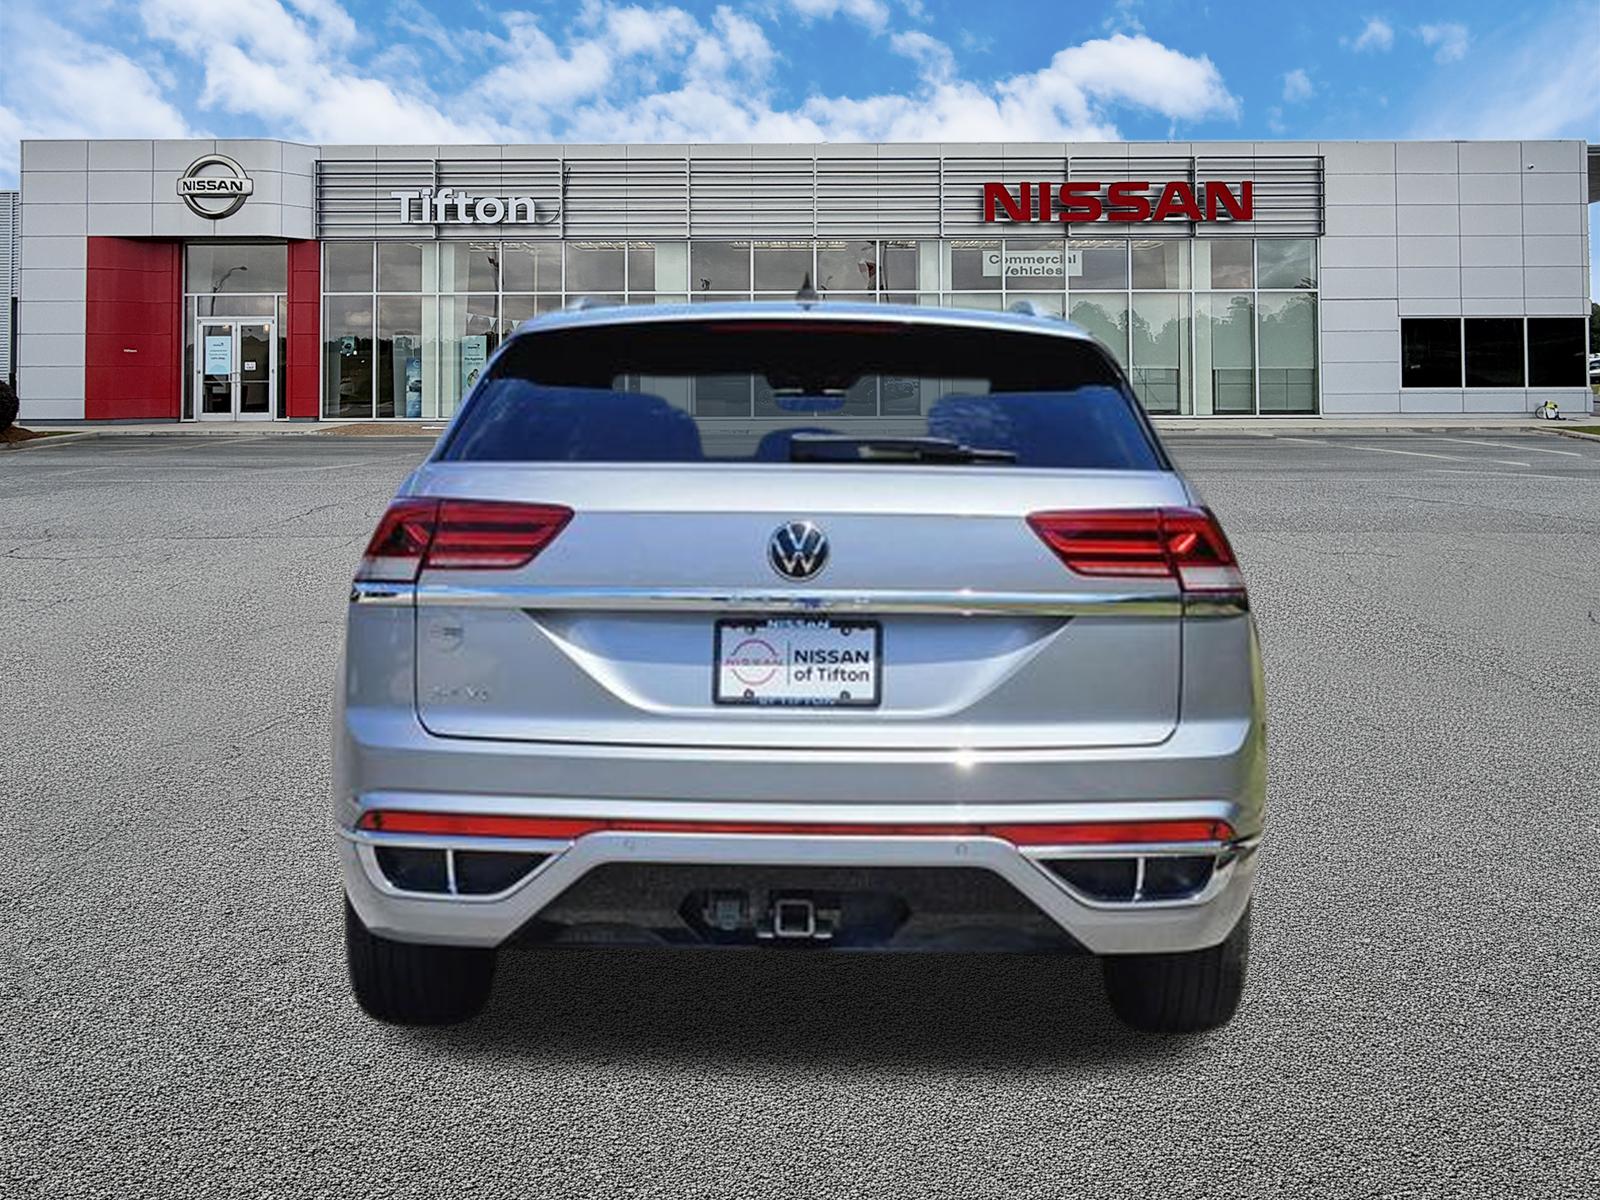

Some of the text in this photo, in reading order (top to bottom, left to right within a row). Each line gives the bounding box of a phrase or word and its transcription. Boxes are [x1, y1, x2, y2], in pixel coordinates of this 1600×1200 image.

[182, 180, 243, 191] NISSAN
[391, 187, 536, 224] Tifton
[983, 181, 1253, 222] NISSAN
[795, 650, 869, 664] NISSAN
[795, 668, 869, 682] of Tifton
